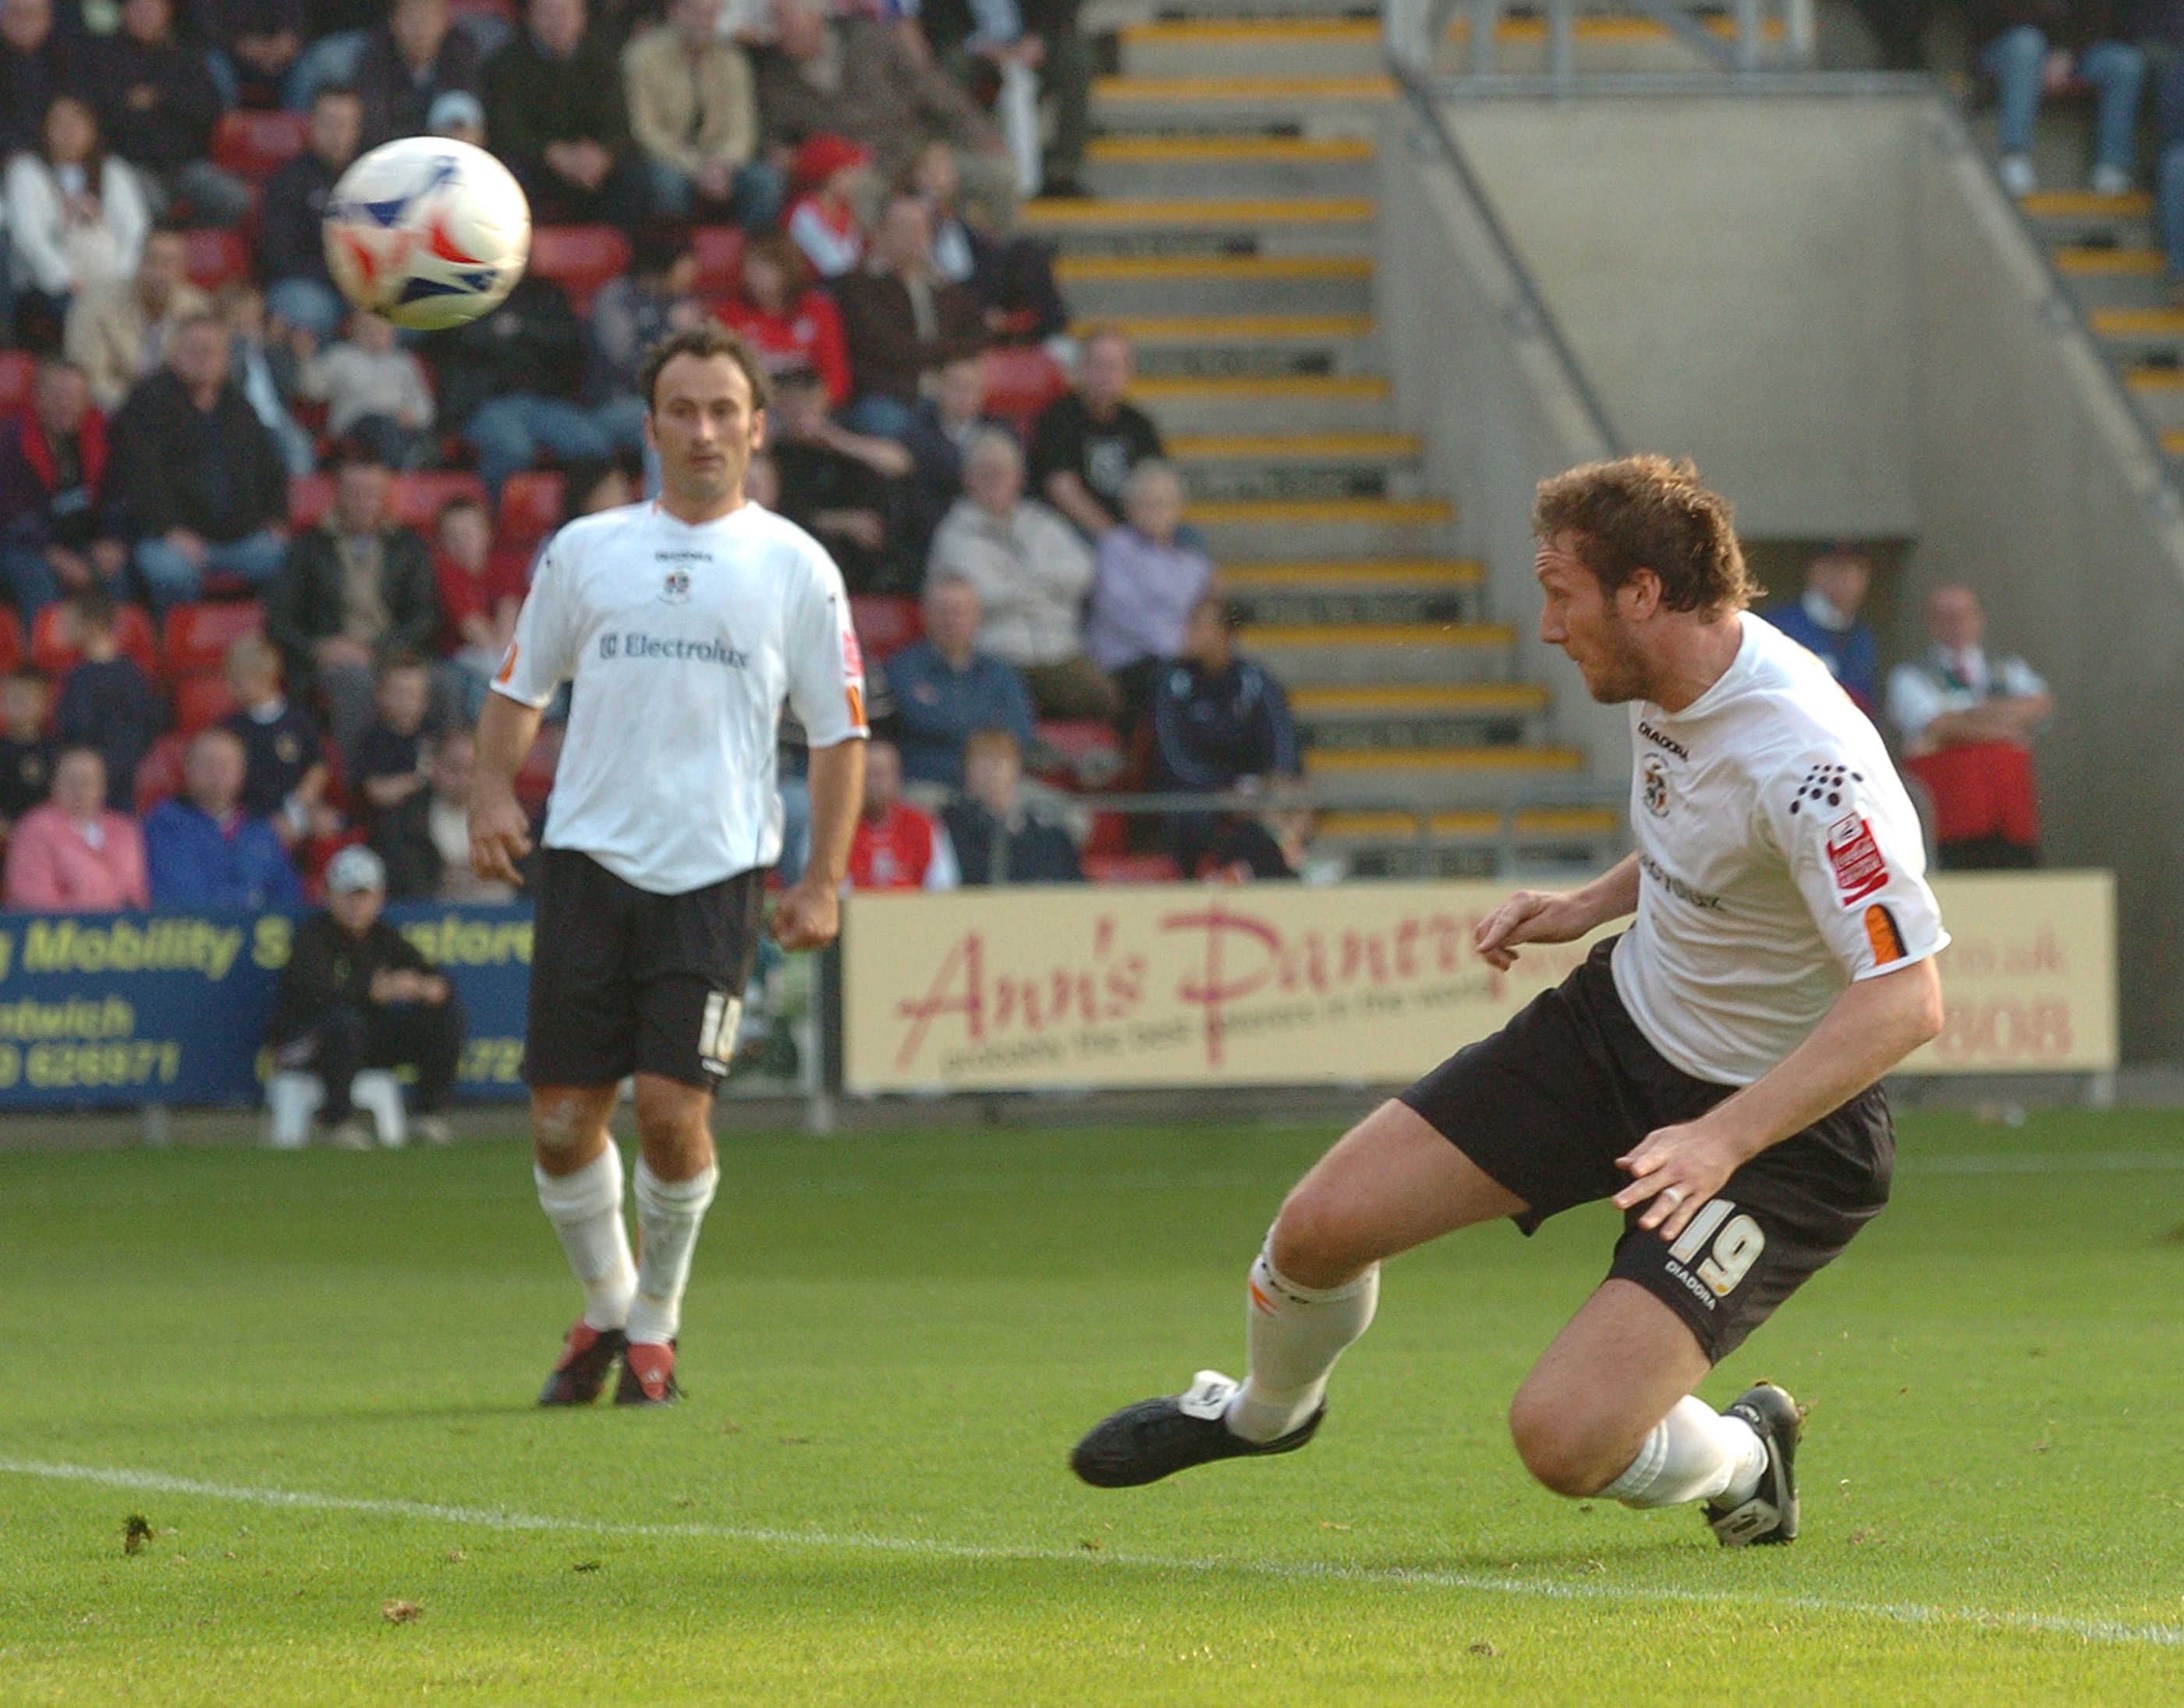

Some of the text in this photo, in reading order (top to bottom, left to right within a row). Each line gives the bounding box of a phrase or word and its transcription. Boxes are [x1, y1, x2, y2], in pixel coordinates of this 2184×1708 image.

[626, 633, 750, 668] Electrolux
[23, 919, 243, 981] Mobility
[893, 916, 1150, 1073] Ann's
[1667, 1199, 1765, 1297] 19
[1665, 1260, 1717, 1311] DIADORA
